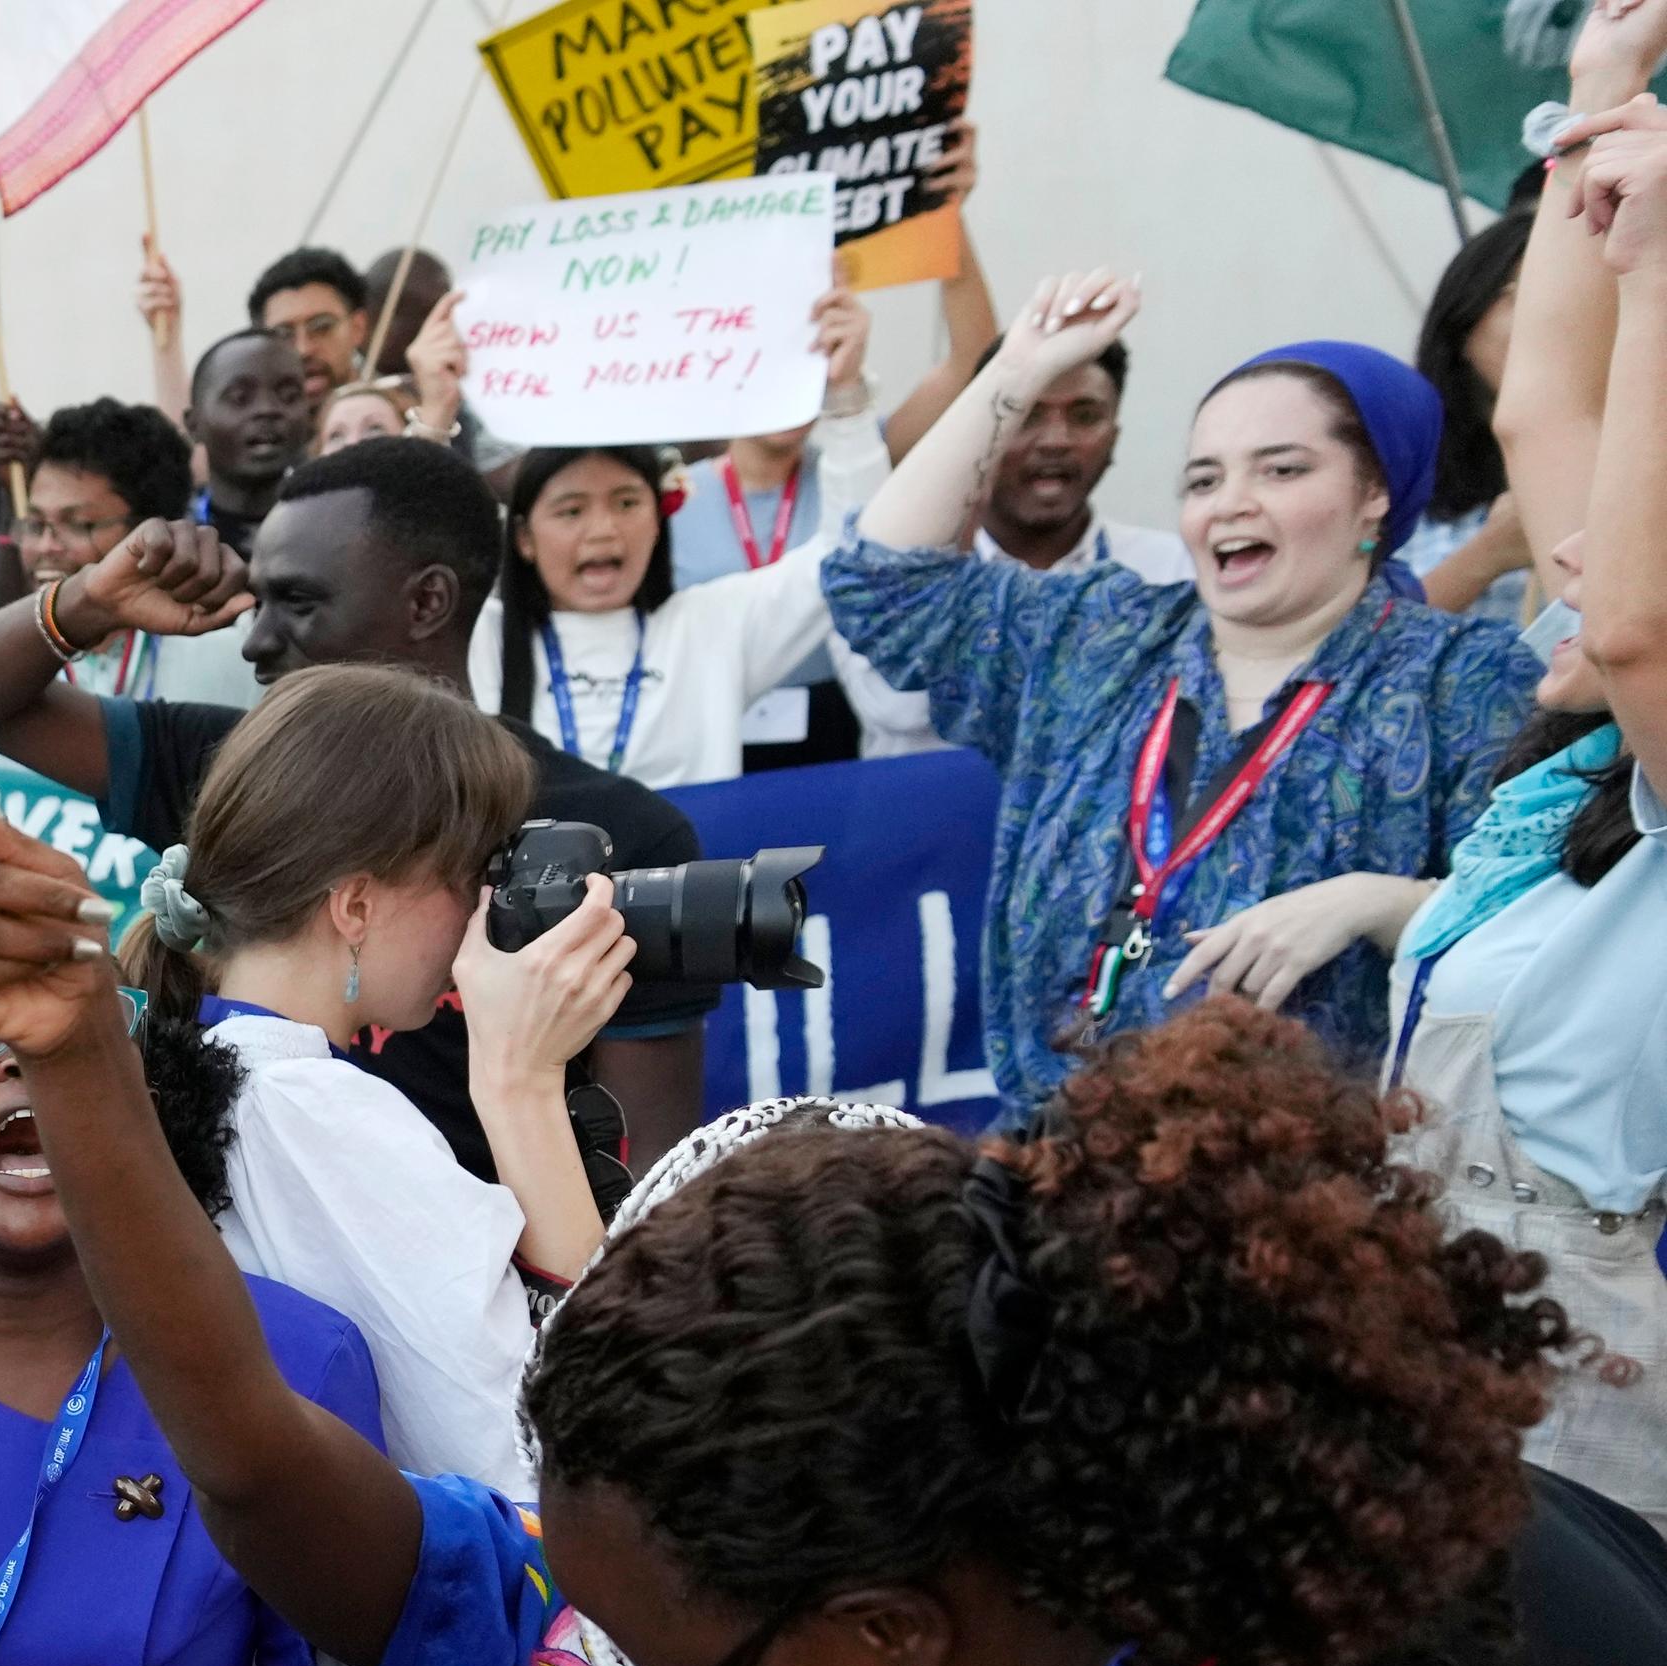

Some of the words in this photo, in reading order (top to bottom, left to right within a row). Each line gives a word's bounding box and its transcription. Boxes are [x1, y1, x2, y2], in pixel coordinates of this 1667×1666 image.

[810, 7, 923, 78] PAY
[633, 70, 747, 171] PAY
[800, 65, 926, 134] YOUR
[471, 218, 535, 261] PAY
[549, 208, 638, 245] LOSS
[682, 184, 826, 228] DAMAGE
[464, 320, 560, 349] SHOW
[594, 311, 641, 339] US
[675, 305, 756, 334] THE
[482, 369, 552, 396] REAL
